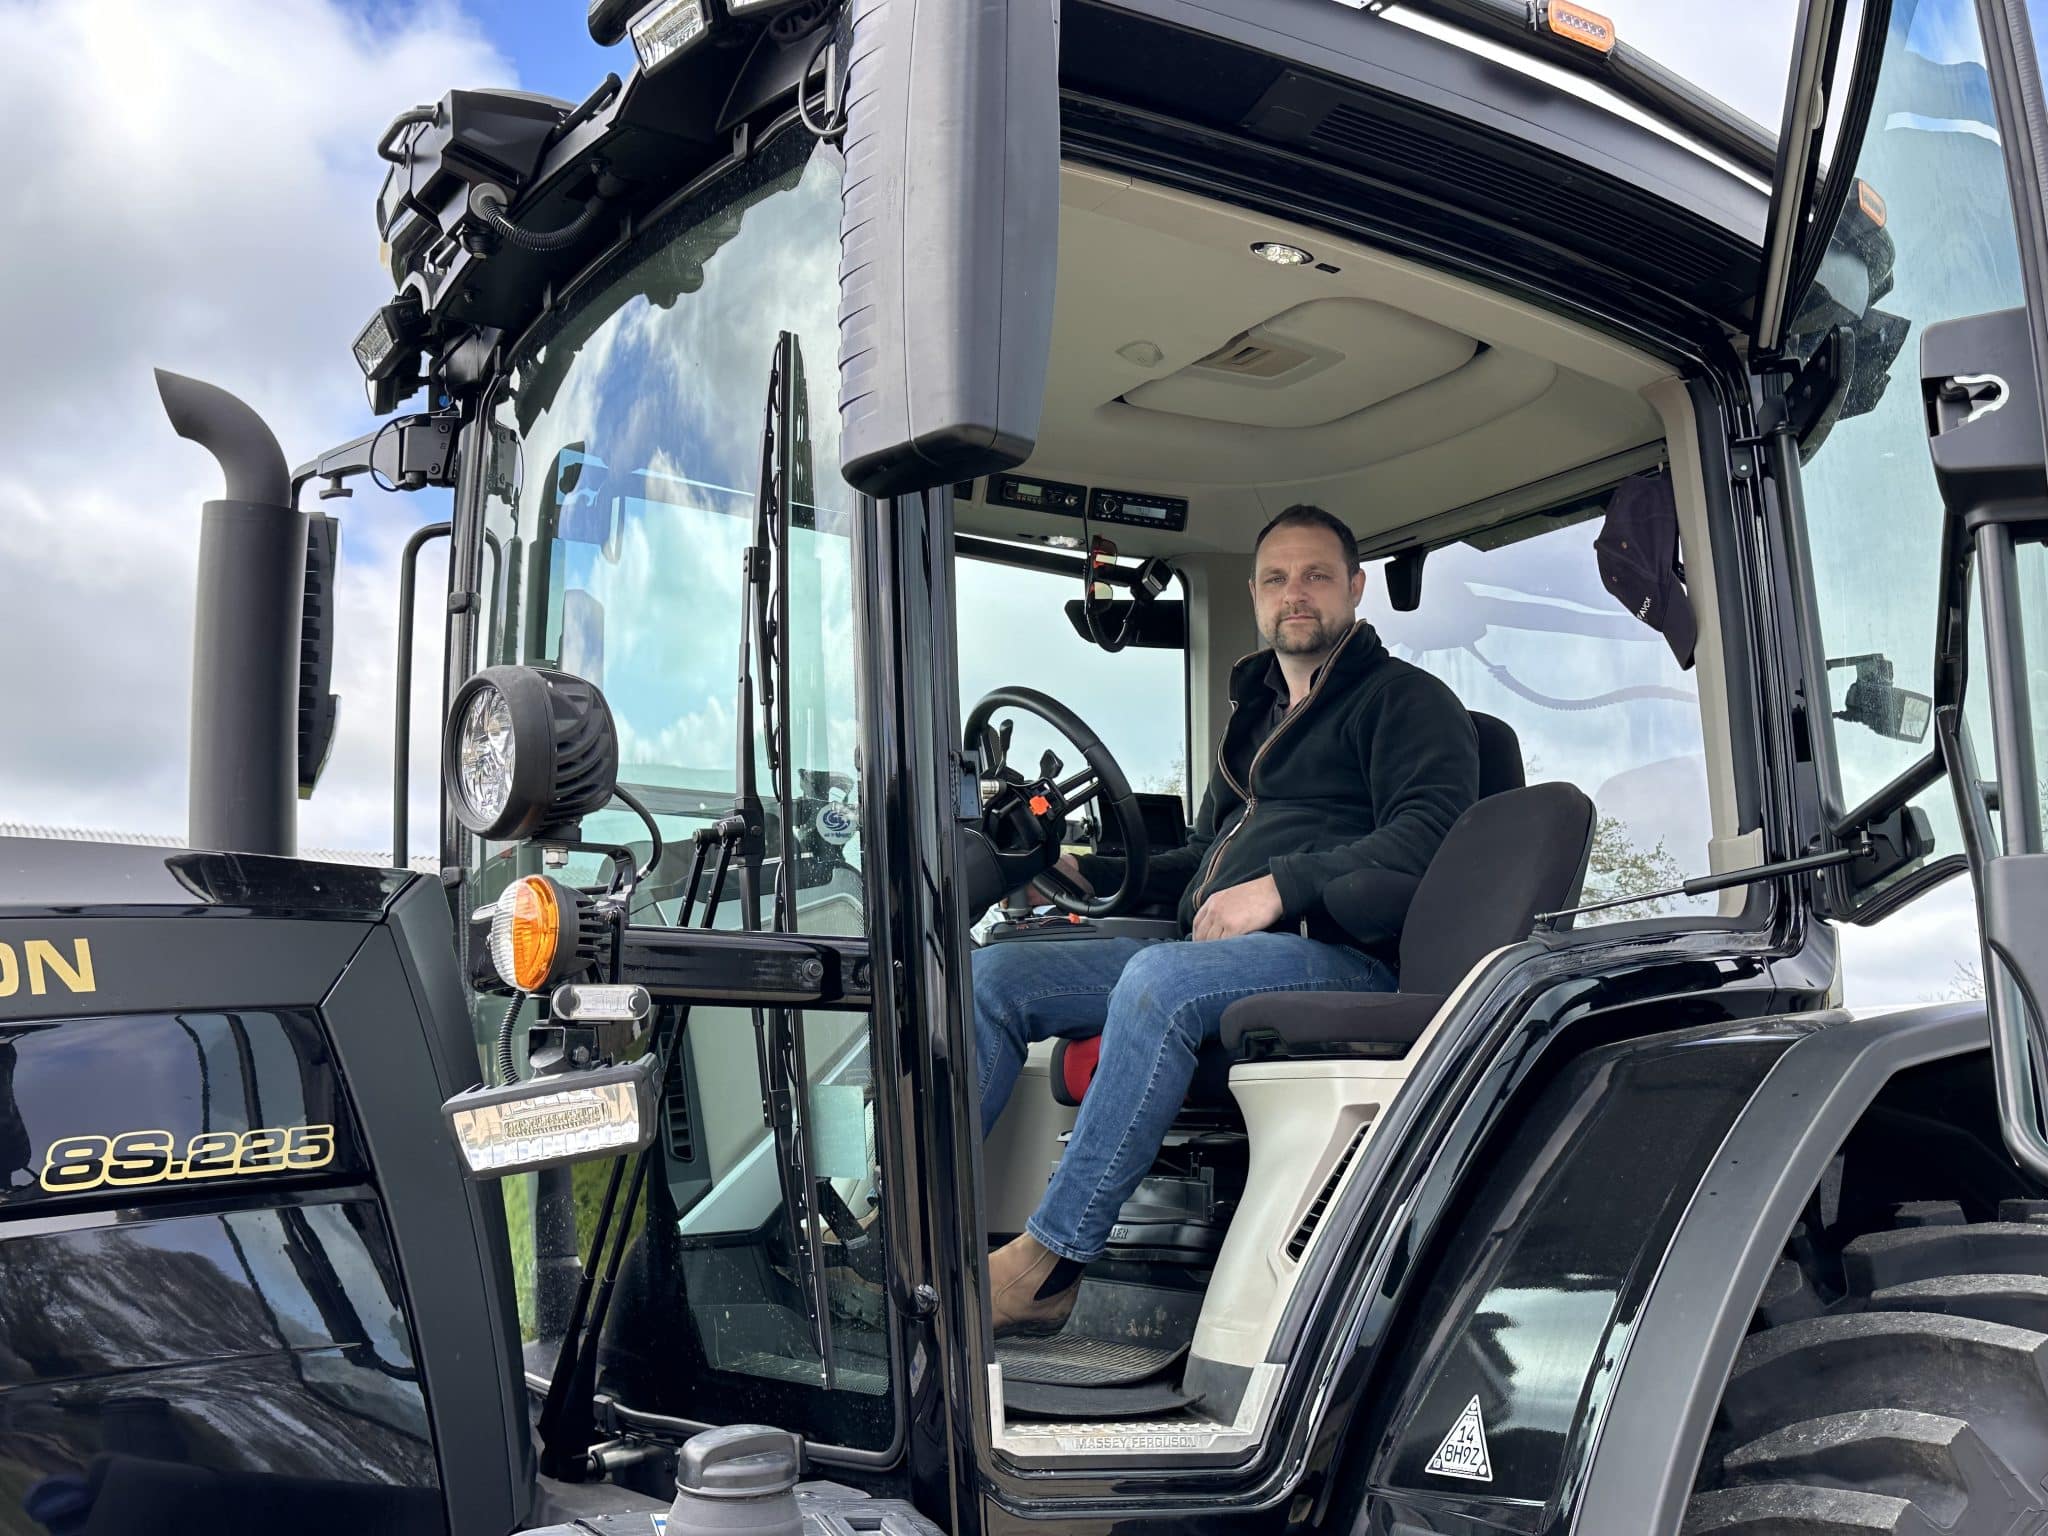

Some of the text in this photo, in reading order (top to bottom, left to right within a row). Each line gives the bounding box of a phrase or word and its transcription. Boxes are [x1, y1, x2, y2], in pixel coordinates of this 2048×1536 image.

[40, 1124, 334, 1192] 8S.225
[1074, 1435, 1197, 1449] MASSEY FERGUSON
[1457, 1425, 1475, 1444] 14
